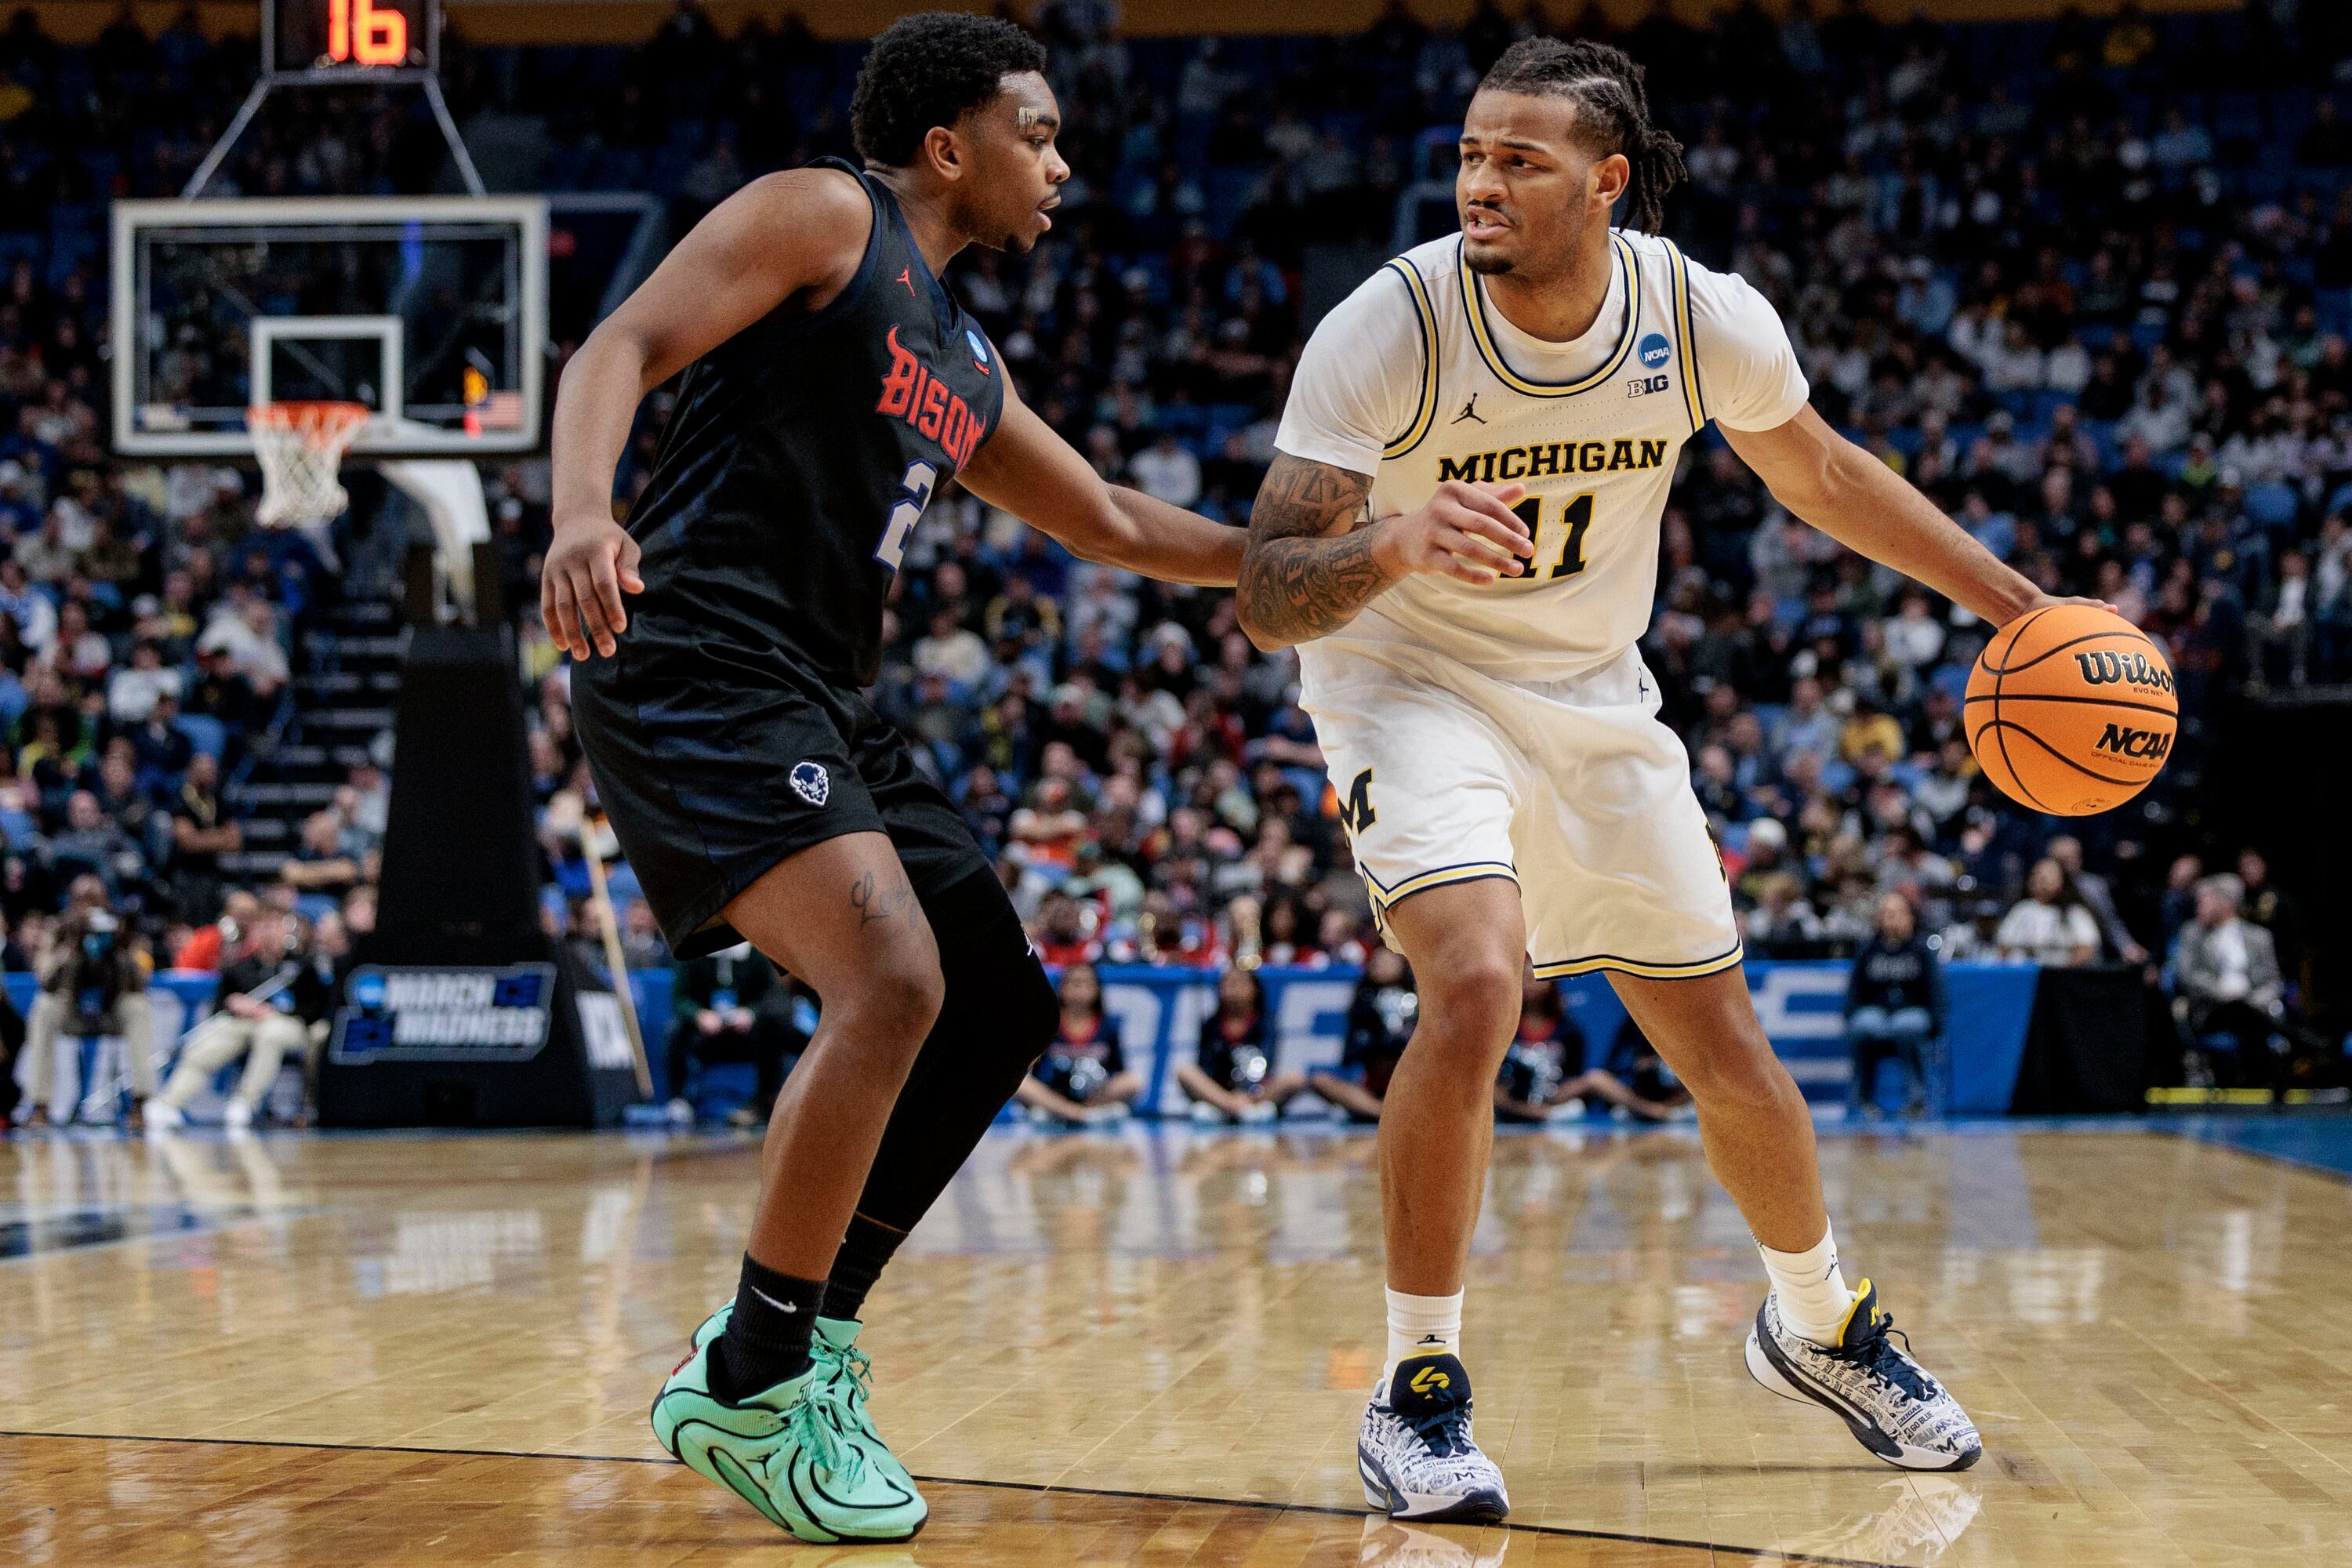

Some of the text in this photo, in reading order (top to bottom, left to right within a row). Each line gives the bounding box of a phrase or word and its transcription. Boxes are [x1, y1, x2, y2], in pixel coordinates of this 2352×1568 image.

[328, 0, 407, 65] 16
[1644, 347, 1670, 362] NCAA
[875, 325, 986, 472] BISON
[1437, 438, 1669, 484] MICHIGAN
[872, 458, 938, 572] 2
[1496, 492, 1595, 580] 11
[2093, 722, 2171, 760] NCAA
[387, 972, 496, 1010] MARCH
[394, 1007, 546, 1047] MADNESS
[1918, 1410, 1935, 1425] BLUE
